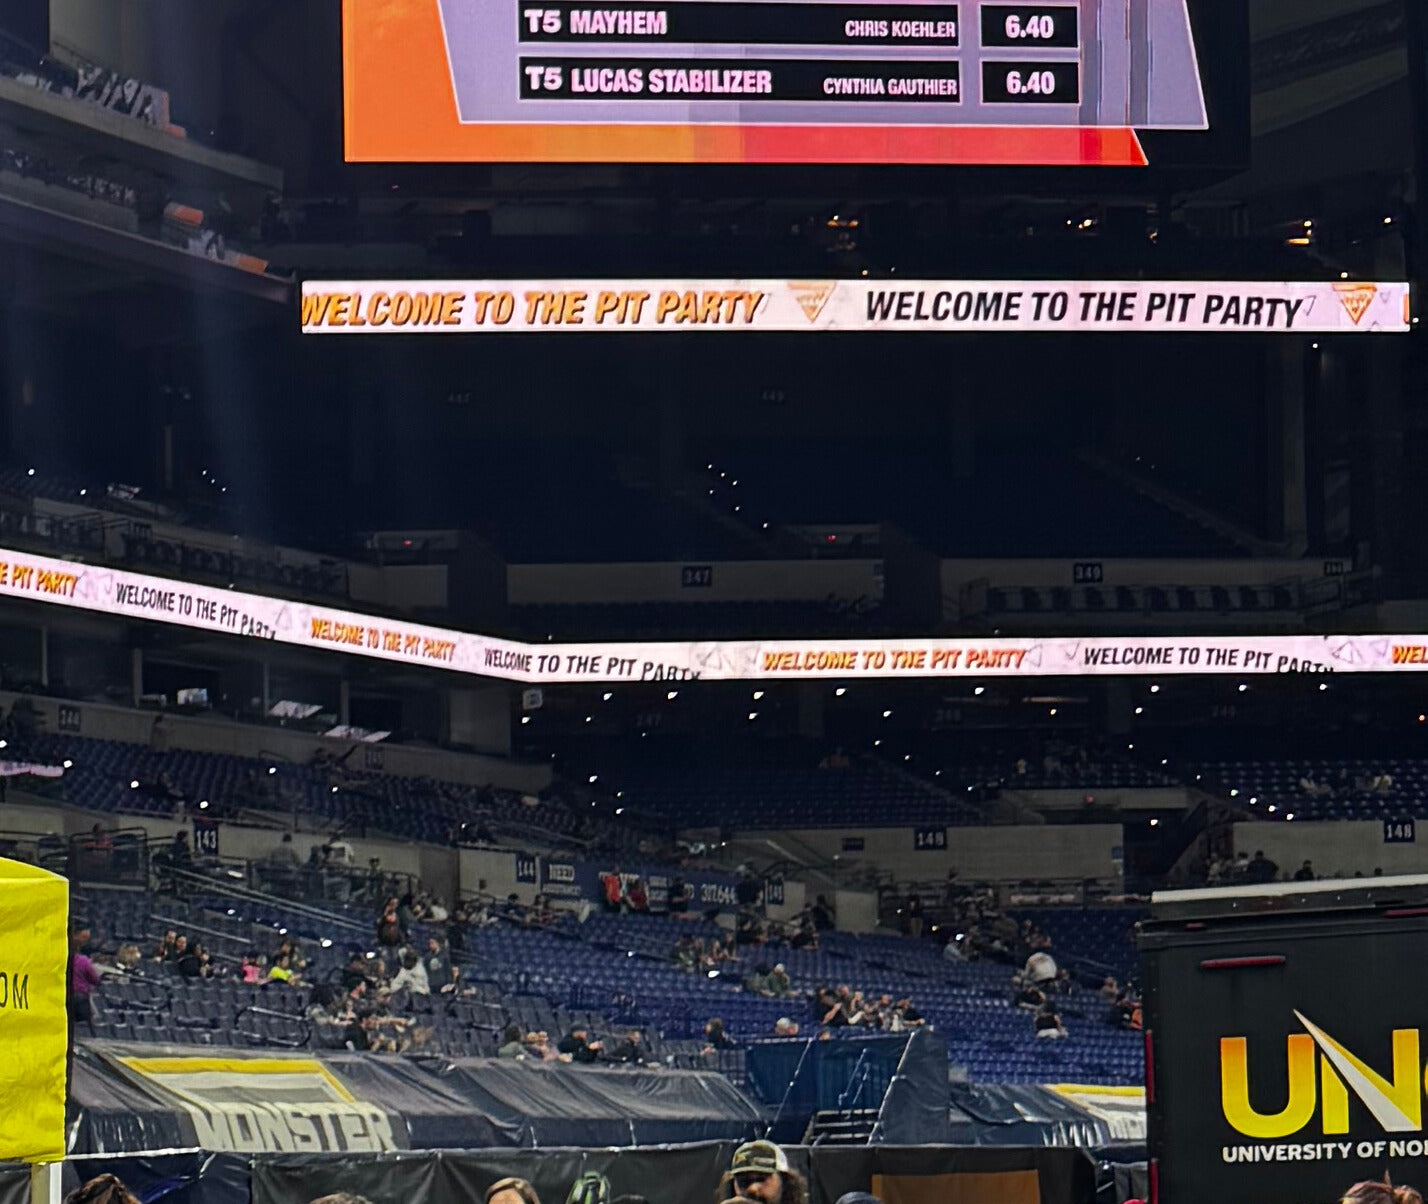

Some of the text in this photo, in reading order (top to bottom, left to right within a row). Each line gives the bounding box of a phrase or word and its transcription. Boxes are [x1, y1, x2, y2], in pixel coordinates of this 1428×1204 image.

[524, 10, 1054, 39] T5 MAYHEM CHRIS KOEHLER 6.40
[525, 66, 1056, 96] T5 LUCAS STABILIZER CYNTHIA GAUTHIER 6.40
[301, 291, 465, 326] WELCOME
[474, 291, 515, 324] TO
[524, 291, 587, 324] THE
[594, 291, 650, 324] PIT
[656, 290, 764, 324] PARTY
[866, 290, 1021, 321] WELCOME
[1030, 291, 1068, 321] TO
[1076, 291, 1136, 322] THE
[1146, 293, 1196, 324] PIT
[1203, 294, 1303, 328] PARTY
[11, 564, 33, 590] PIT
[36, 568, 79, 598] PARTY
[116, 582, 175, 612] WELCOME
[178, 593, 192, 616] TO
[196, 598, 217, 621] THE
[220, 604, 238, 628] PIT
[311, 617, 456, 662] WELCOME TO THE PIT PARTY
[484, 647, 532, 672] WELCOME
[537, 654, 560, 673] TO
[565, 655, 602, 674] THE
[606, 658, 637, 676] PIT
[762, 649, 1027, 671] WELCOME TO THE PIT PARTY
[1084, 647, 1334, 673] WELCOME TO THE PIT PAR
[196, 830, 217, 850] 143
[518, 860, 535, 877] 144
[1220, 1008, 1428, 1138] UN
[180, 1100, 398, 1152] MONSTER
[1222, 1140, 1428, 1163] UNIVERSITY OF NO
